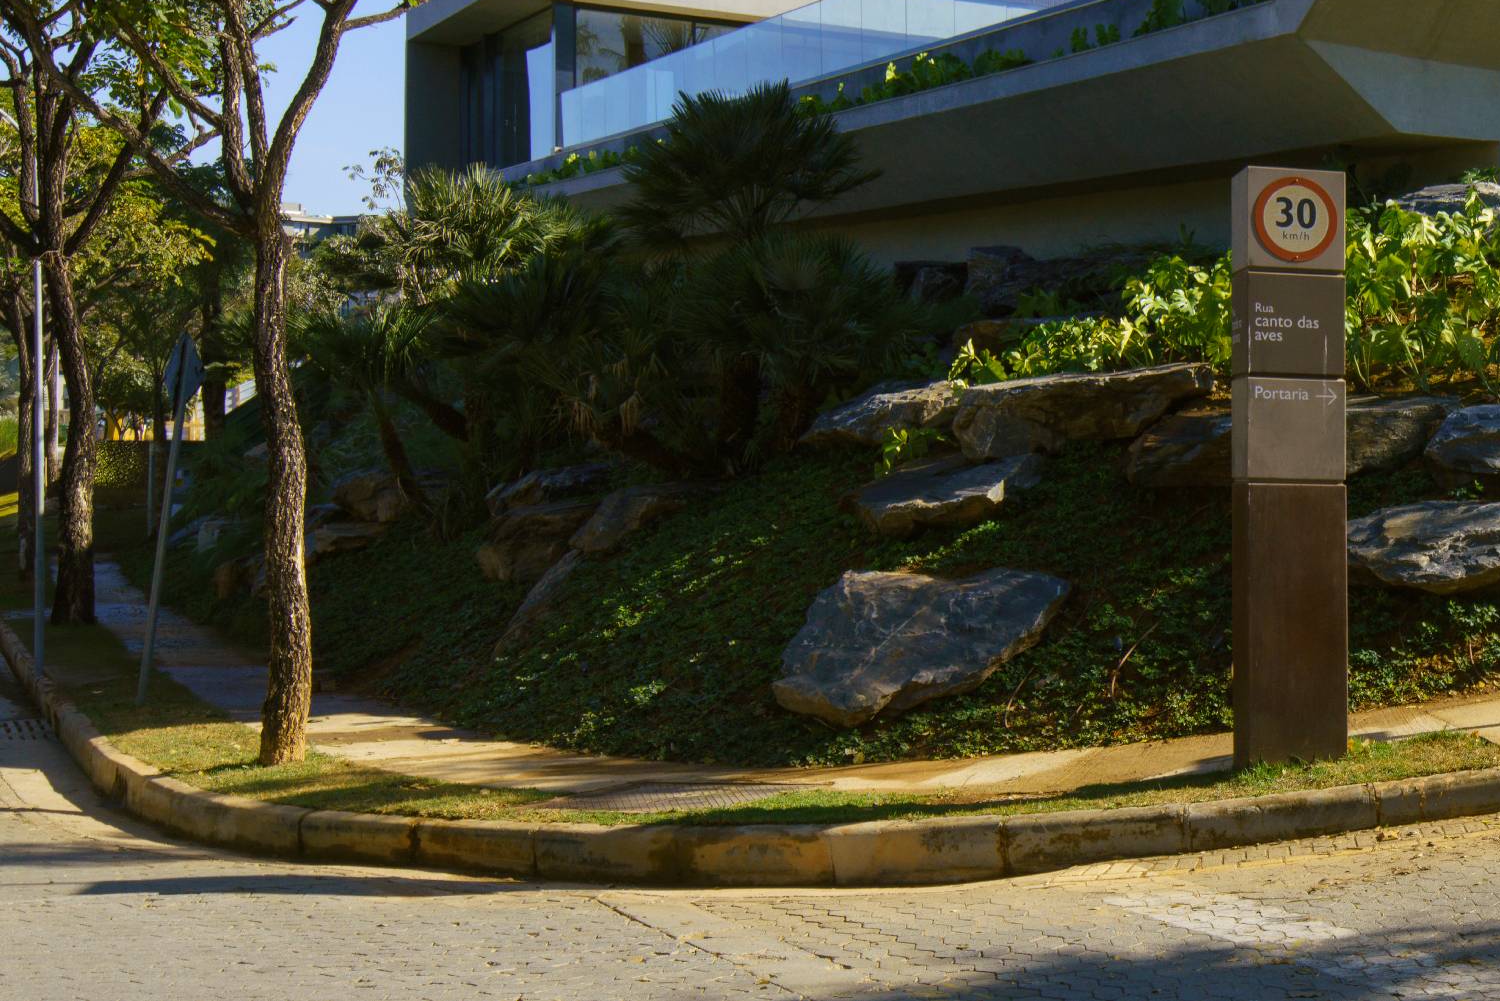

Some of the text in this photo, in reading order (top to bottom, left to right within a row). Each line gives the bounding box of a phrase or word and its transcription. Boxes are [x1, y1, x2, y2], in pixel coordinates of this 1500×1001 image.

[1275, 196, 1316, 229] 30
[1282, 232, 1310, 241] km/h
[1255, 302, 1274, 313] Rua
[1255, 315, 1320, 329] canto das
[1254, 331, 1283, 342] aves
[1255, 385, 1309, 400] Portaria
